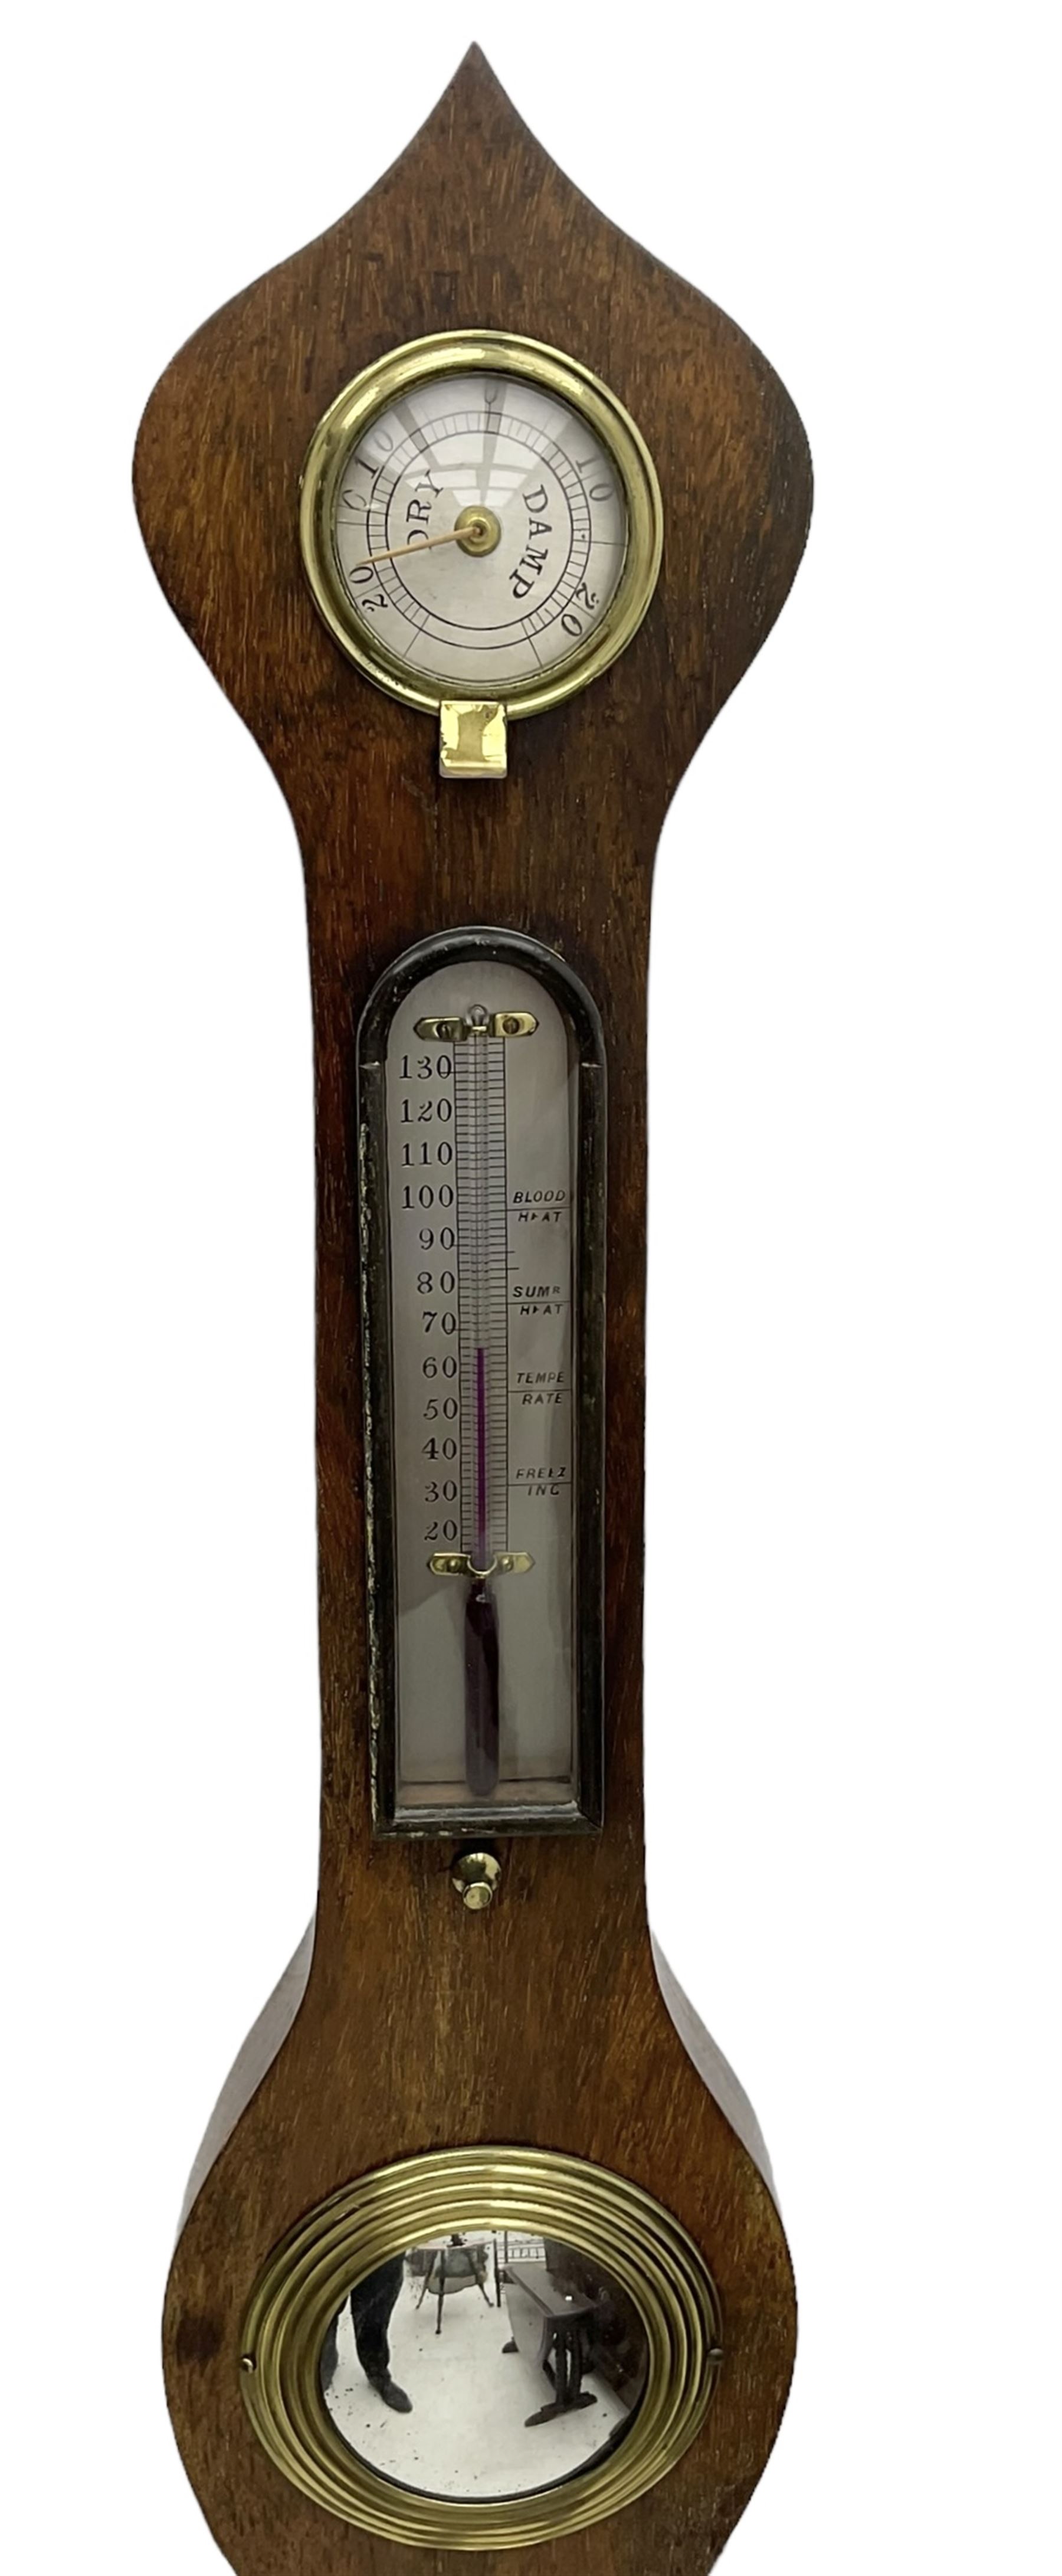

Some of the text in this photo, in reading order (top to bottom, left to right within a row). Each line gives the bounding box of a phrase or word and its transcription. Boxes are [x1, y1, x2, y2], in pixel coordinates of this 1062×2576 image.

[509, 484, 552, 598] DAMP
[349, 566, 388, 612] 20
[561, 582, 599, 636] 20
[399, 1055, 453, 1079] 130
[401, 1099, 453, 1122] 120
[401, 1142, 453, 1166] 110
[402, 1184, 454, 1209] 100
[513, 1190, 566, 1203] BLOOD
[419, 1228, 455, 1250] 90
[417, 1271, 455, 1294] 80
[421, 1312, 456, 1334] 70
[422, 1356, 457, 1379] 60
[517, 1371, 565, 1384] TEMPE
[423, 1398, 458, 1420] 50
[522, 1393, 563, 1405] RATE
[422, 1438, 457, 1460] 40
[425, 1482, 457, 1503] 30
[424, 1521, 457, 1541] 20
